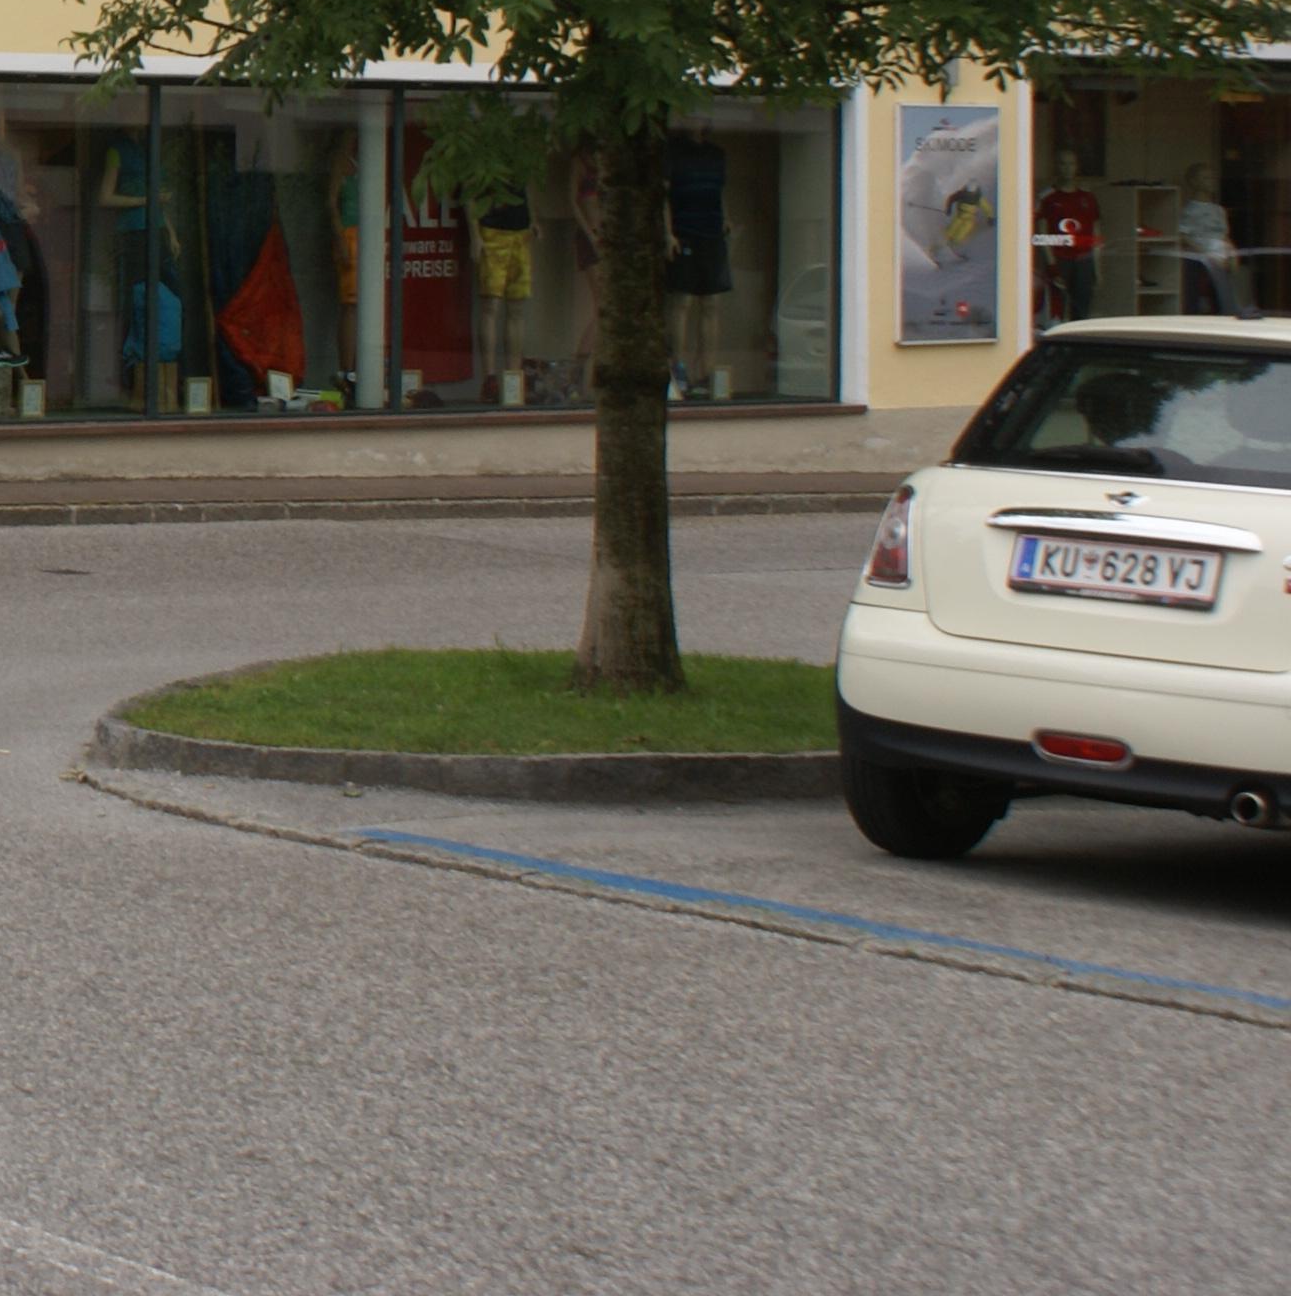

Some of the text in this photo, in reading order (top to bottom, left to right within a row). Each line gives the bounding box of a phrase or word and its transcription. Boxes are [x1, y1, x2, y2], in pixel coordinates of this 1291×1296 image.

[1040, 543, 1205, 591] KU 628 VJ
